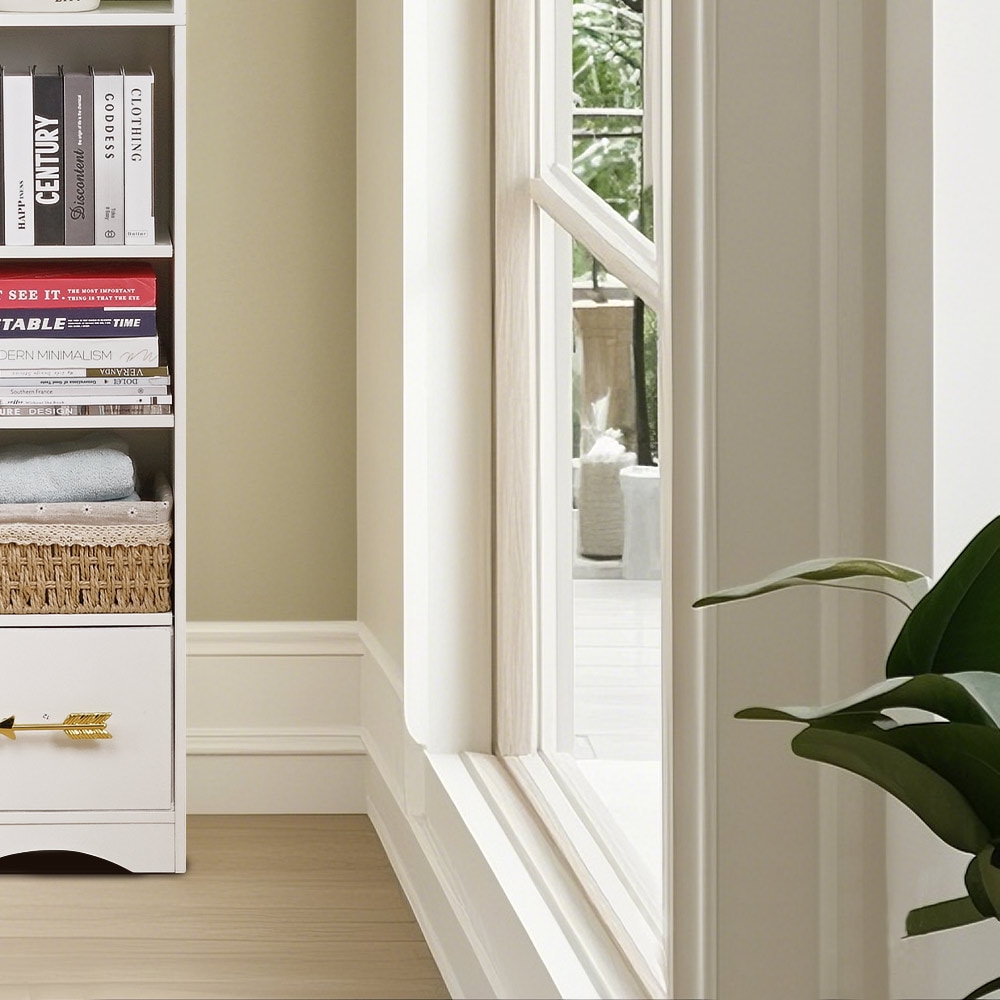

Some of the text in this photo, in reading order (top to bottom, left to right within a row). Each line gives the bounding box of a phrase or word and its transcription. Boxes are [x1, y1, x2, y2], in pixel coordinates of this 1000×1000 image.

[104, 93, 115, 159] GODDESS
[130, 88, 142, 162] CLOTHING
[35, 114, 60, 205] CENTURY
[70, 147, 85, 220] Discontent
[8, 289, 39, 300] SEE
[113, 318, 141, 327] TIME
[37, 349, 112, 361] MINIMALISM
[99, 368, 144, 377] VERANDA
[28, 407, 73, 416] DESIGN
